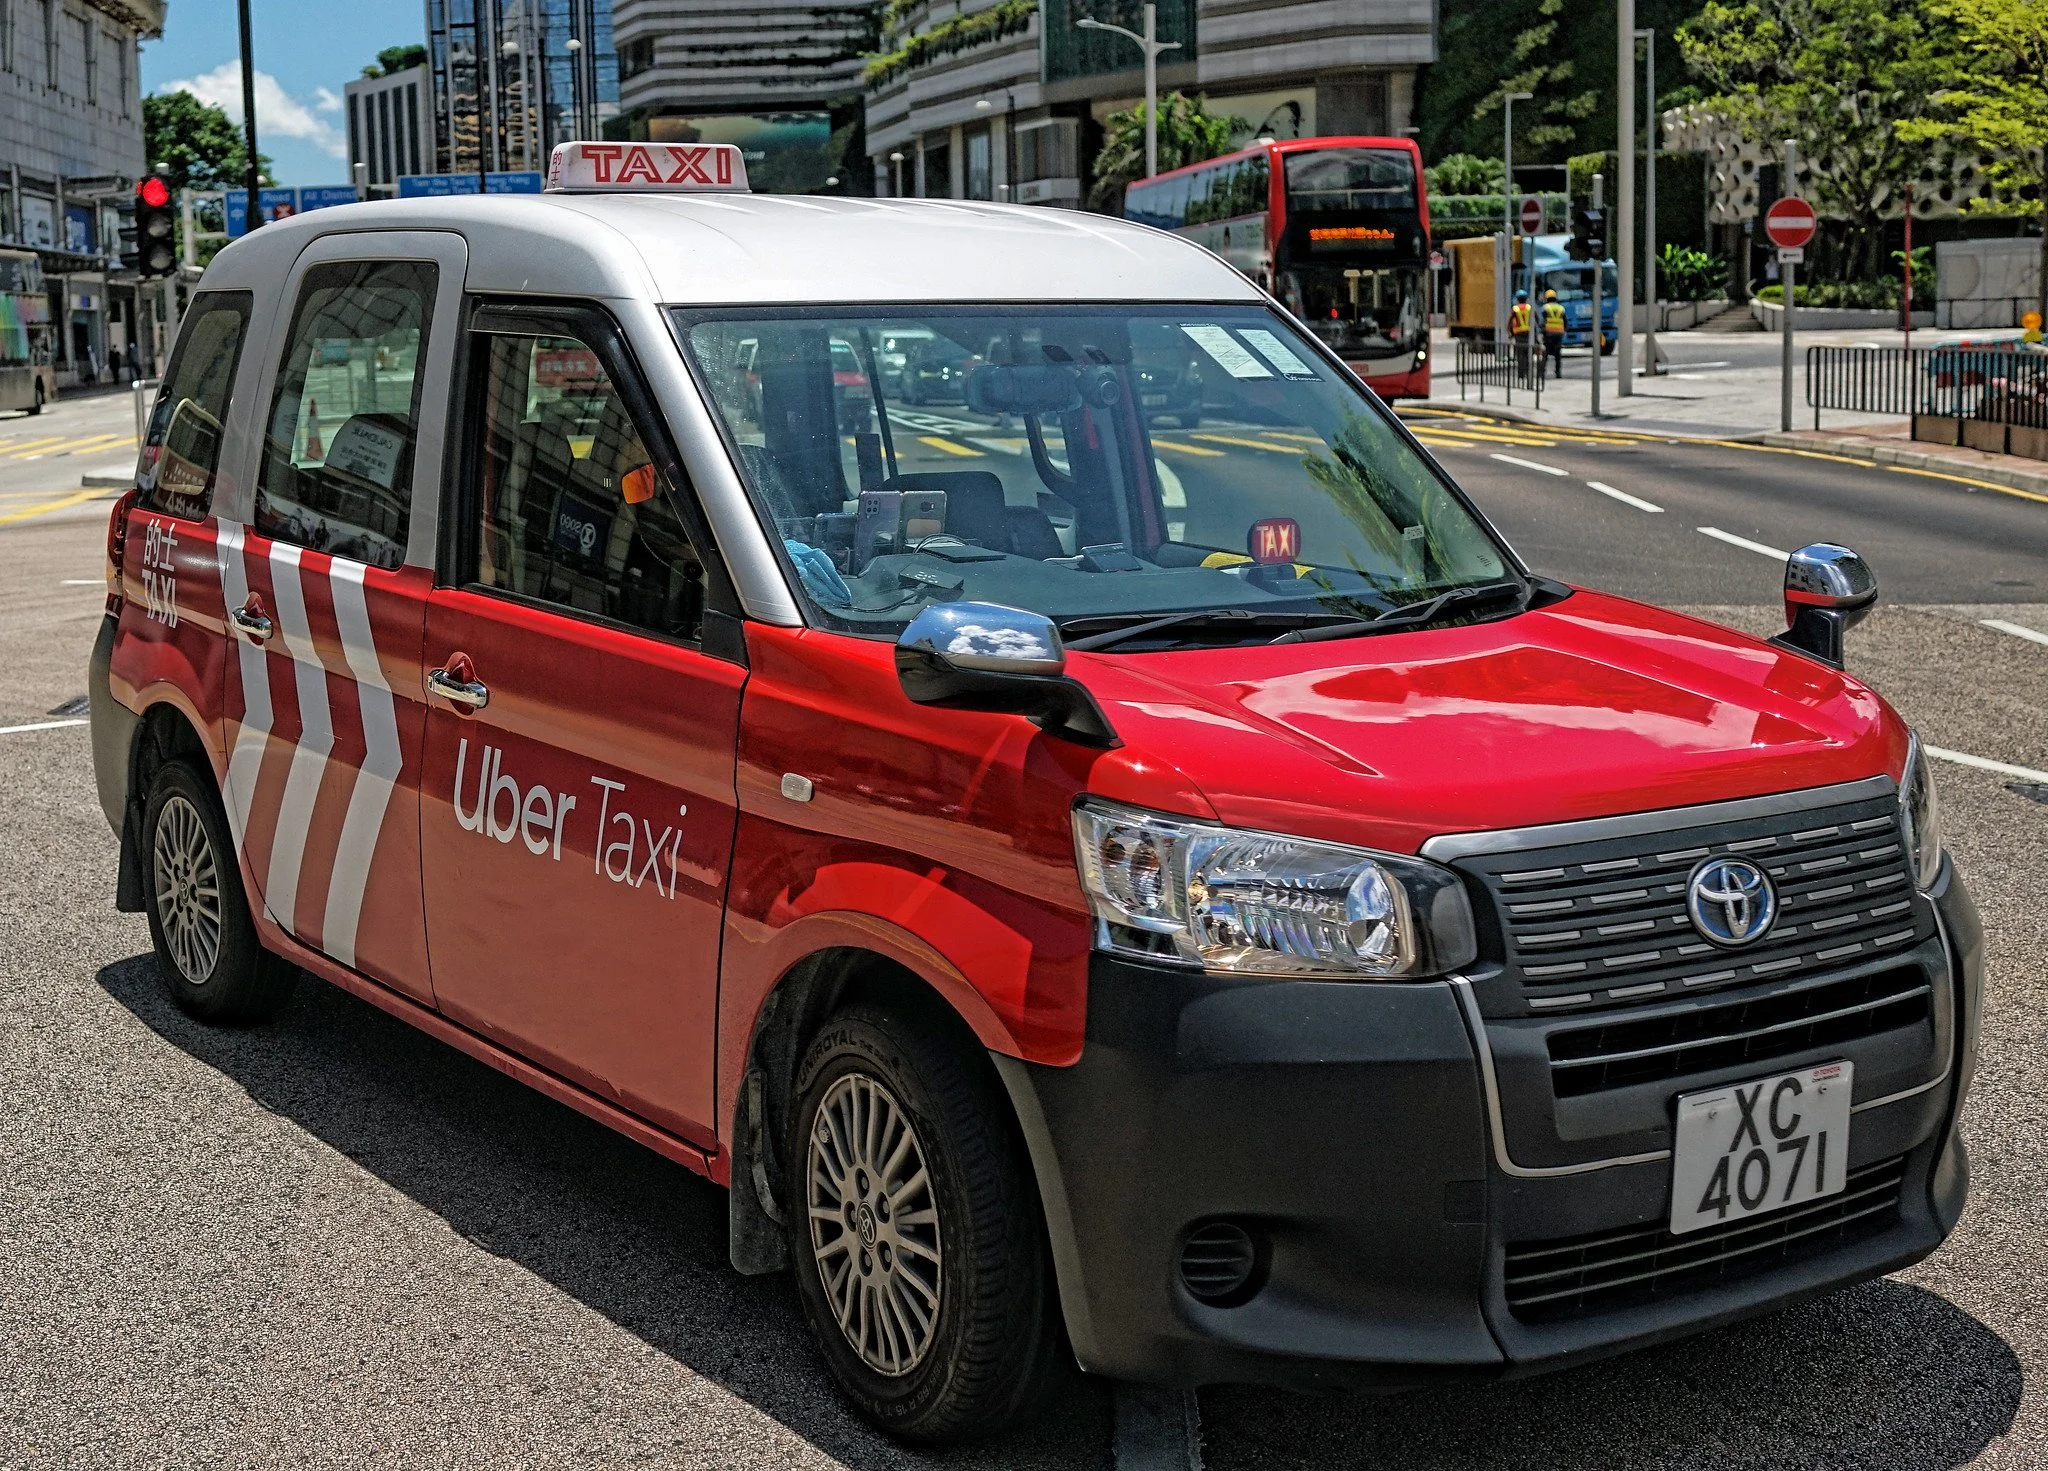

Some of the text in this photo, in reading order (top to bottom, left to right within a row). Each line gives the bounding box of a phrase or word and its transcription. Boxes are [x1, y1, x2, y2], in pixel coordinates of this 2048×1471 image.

[550, 149, 563, 182] 的士
[581, 144, 732, 185] TAXI
[143, 518, 179, 572] 的士
[1256, 524, 1296, 558] TAXI
[141, 568, 178, 629] TAXI
[453, 737, 688, 901] Uber Taxi
[1728, 1076, 1803, 1153] XC
[1696, 1130, 1827, 1220] 4071
